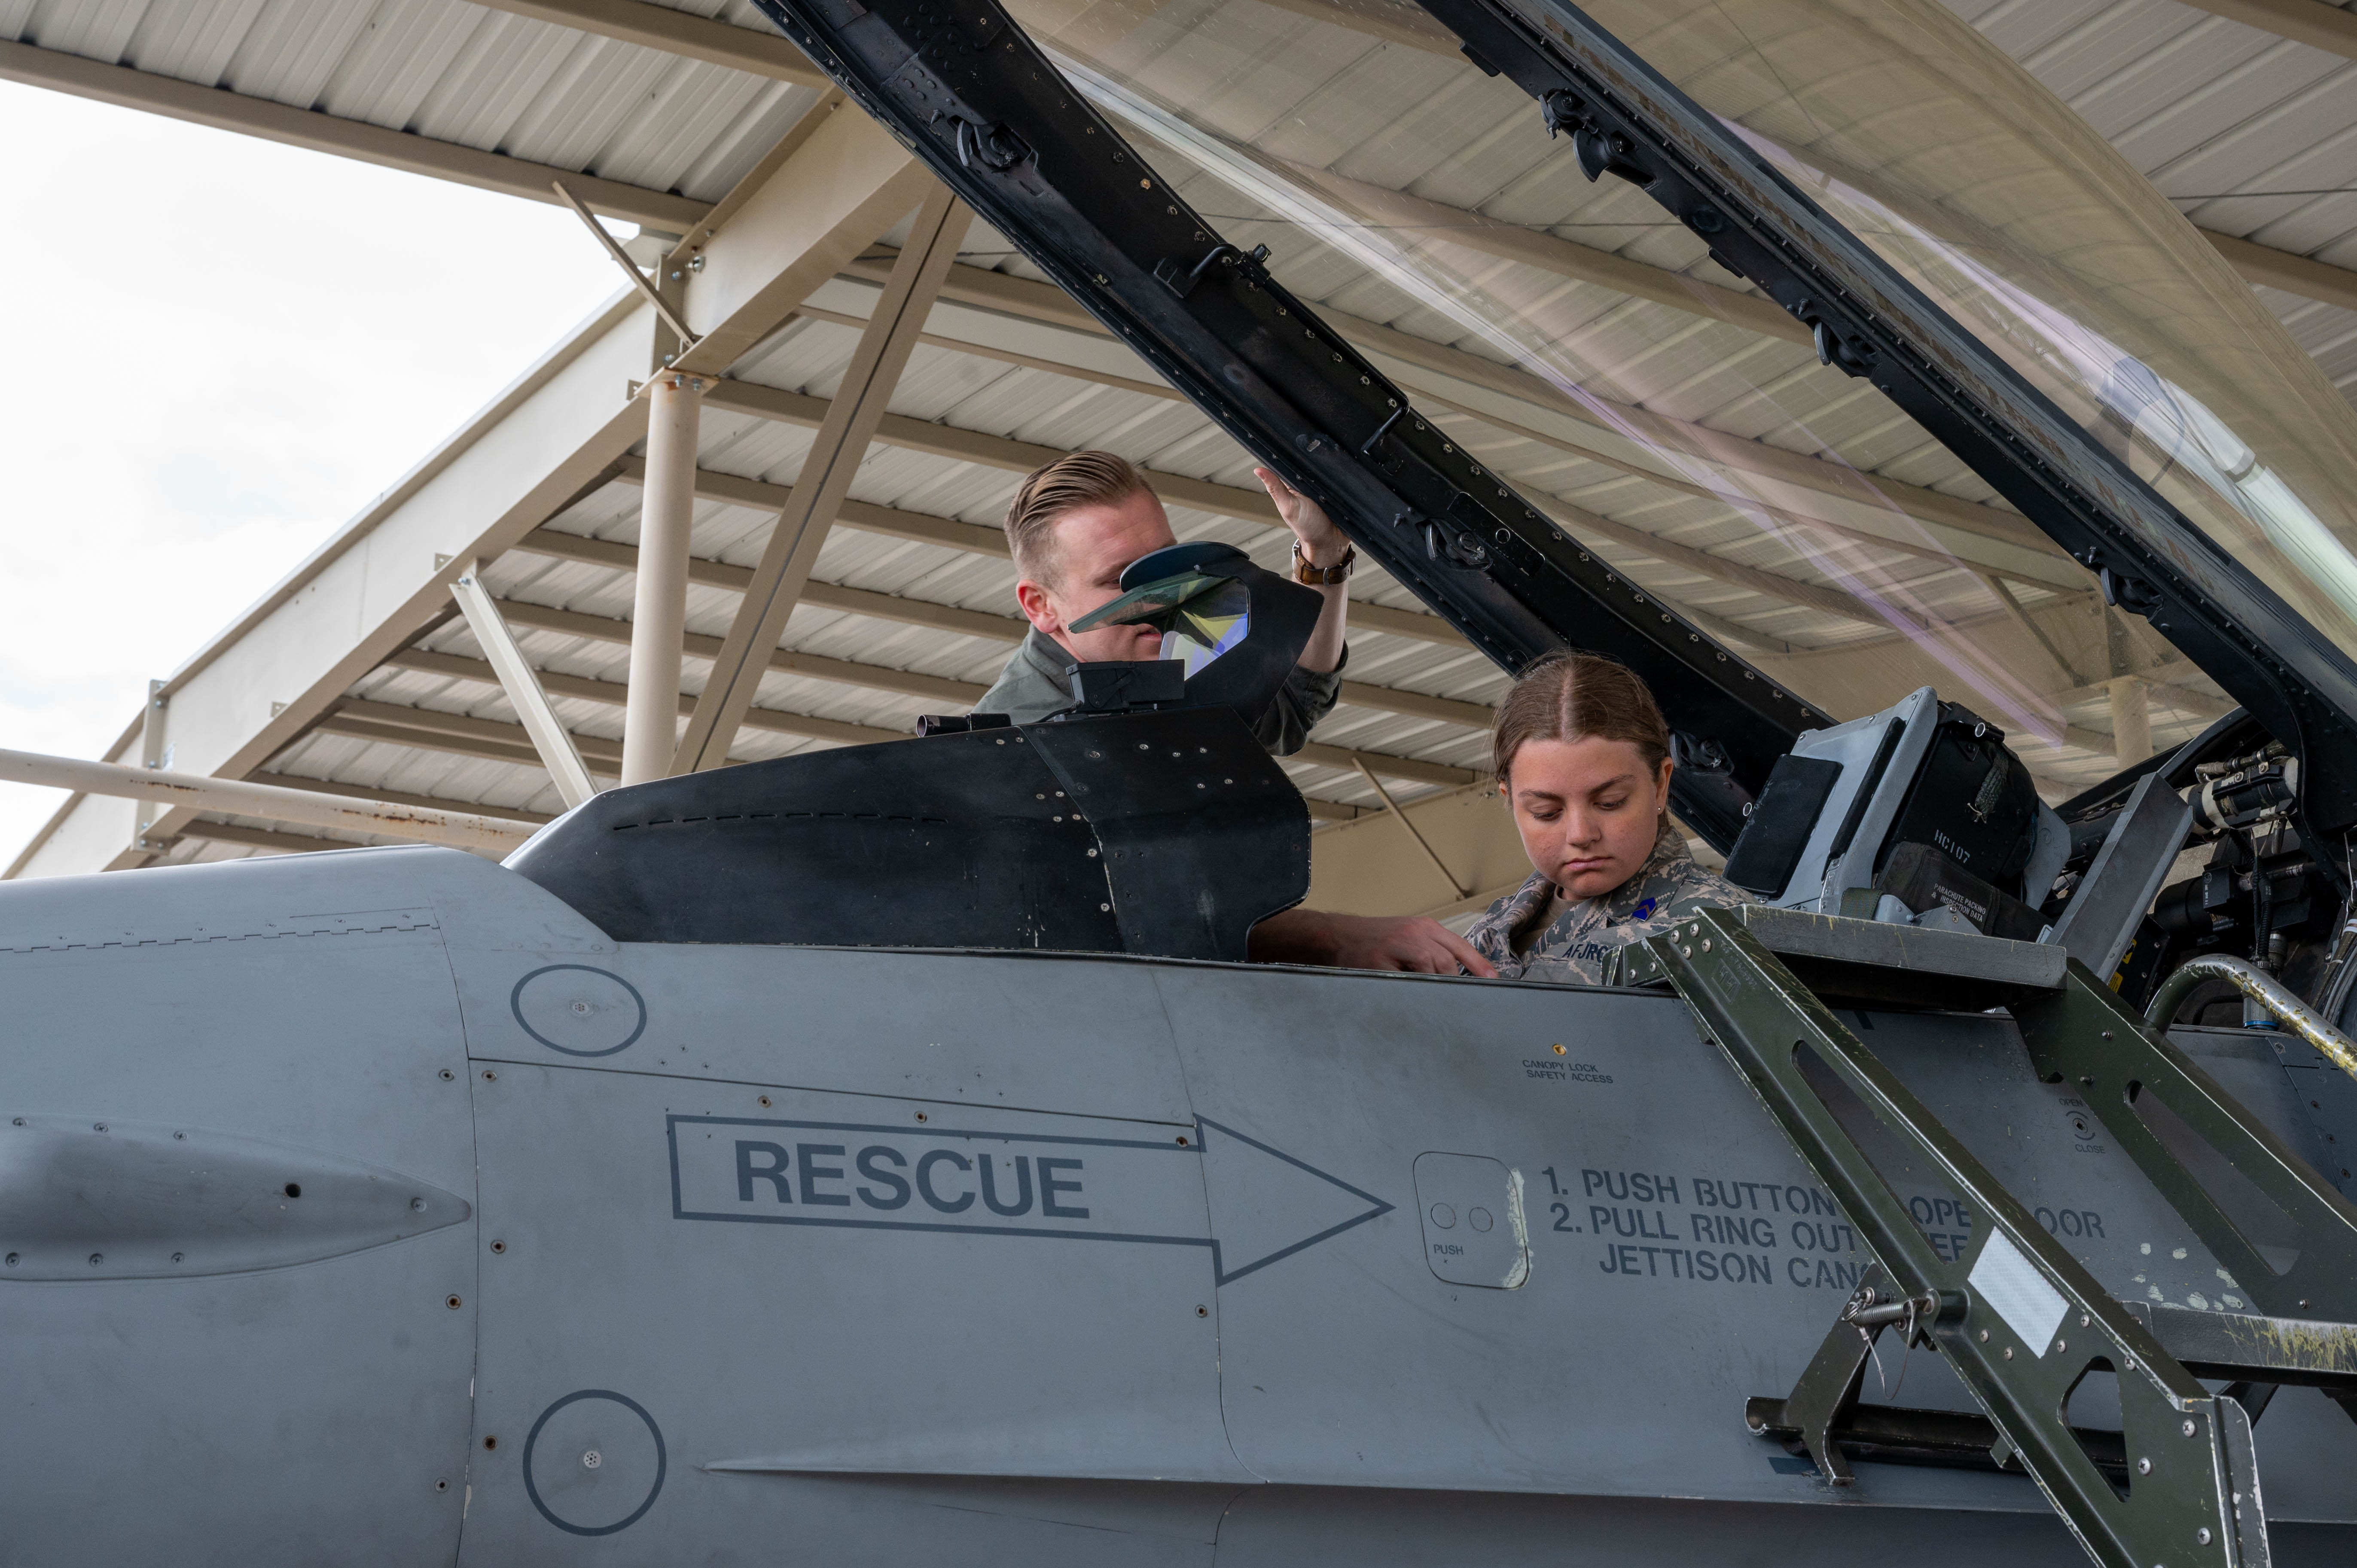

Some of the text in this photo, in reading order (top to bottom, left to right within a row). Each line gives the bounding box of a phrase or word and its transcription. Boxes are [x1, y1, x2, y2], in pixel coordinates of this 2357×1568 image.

[1934, 883, 1986, 915] PARACHUTE PACKING
[1940, 895, 1970, 915] INSPECTION
[1970, 910, 1983, 923] DATA
[1562, 943, 1613, 963] AFJRO
[1522, 1060, 1598, 1073] CANOPY LOCK
[1526, 1069, 1613, 1084] SAFETY ACCESS
[2059, 1098, 2083, 1107] OPEN
[2075, 1144, 2106, 1154] CLOSE
[735, 1140, 1090, 1218] RESCUE
[1542, 1166, 2105, 1239] 1. PUSH BUTTON OPE OOR
[1550, 1203, 1583, 1233] 2.
[1590, 1206, 1679, 1240] PULL
[1691, 1214, 1777, 1248] RING
[1791, 1221, 1856, 1253] OUT
[1433, 1244, 1464, 1255] PUSH
[1599, 1244, 1869, 1290] JETTISON CAN
